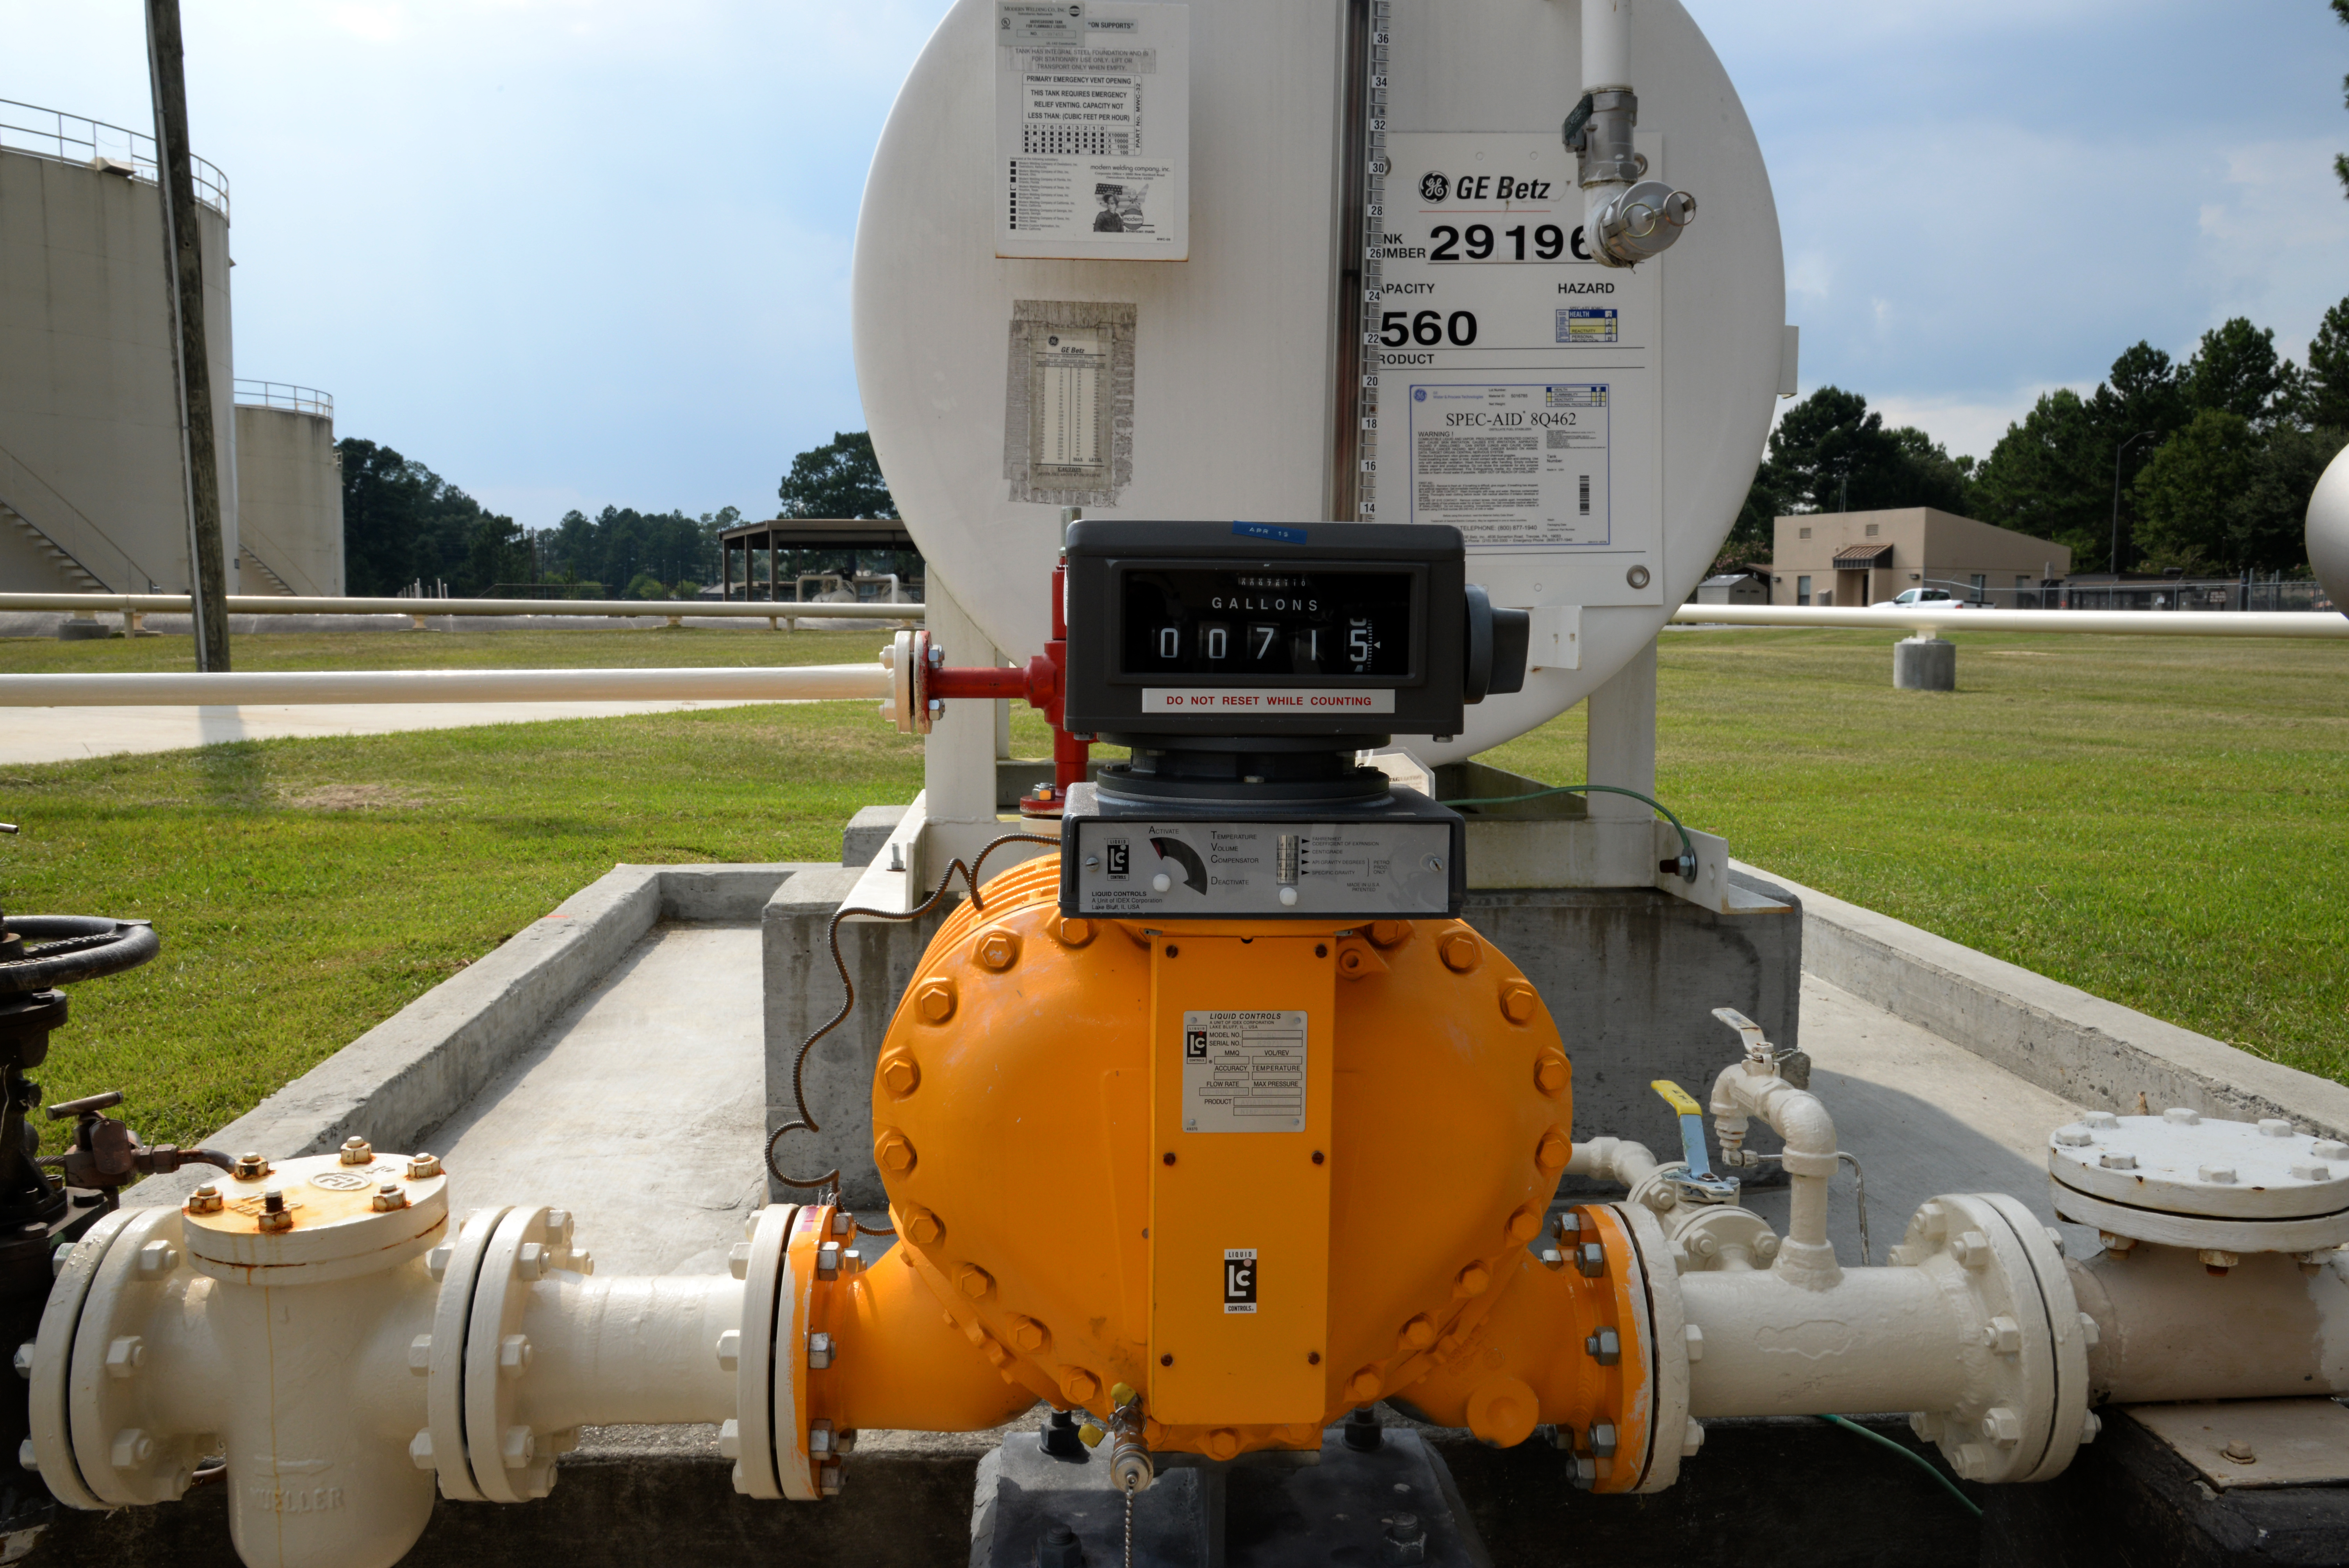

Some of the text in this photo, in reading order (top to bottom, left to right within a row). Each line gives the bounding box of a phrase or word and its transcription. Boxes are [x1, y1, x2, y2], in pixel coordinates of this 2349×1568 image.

[1378, 34, 1389, 43] 36
[1376, 77, 1387, 87] 34
[1374, 120, 1385, 130] 32
[1372, 163, 1384, 173] 30
[1457, 176, 1490, 199] GE
[1497, 176, 1551, 200] Betz
[1371, 206, 1383, 215] 28
[1384, 233, 1403, 244] NK
[1370, 249, 1381, 258] 26
[1558, 283, 1615, 294] HAZARD
[1369, 291, 1380, 301] 24
[1380, 310, 1477, 347] 560
[1368, 334, 1379, 343] 22
[1380, 354, 1435, 364] RODUCT
[1367, 376, 1378, 386] 20
[1366, 419, 1377, 428] 18
[1531, 412, 1576, 428] 8Q462
[1365, 461, 1376, 471] 16
[1364, 504, 1375, 513] 14
[1212, 597, 1317, 611] GALLONS
[1167, 696, 1372, 706] DO NOT RESET WHILE COUNTING
[1211, 831, 1257, 839] TEMPERATURE
[1211, 843, 1238, 852] VOLUME
[1211, 855, 1259, 863] COMPENSATOR
